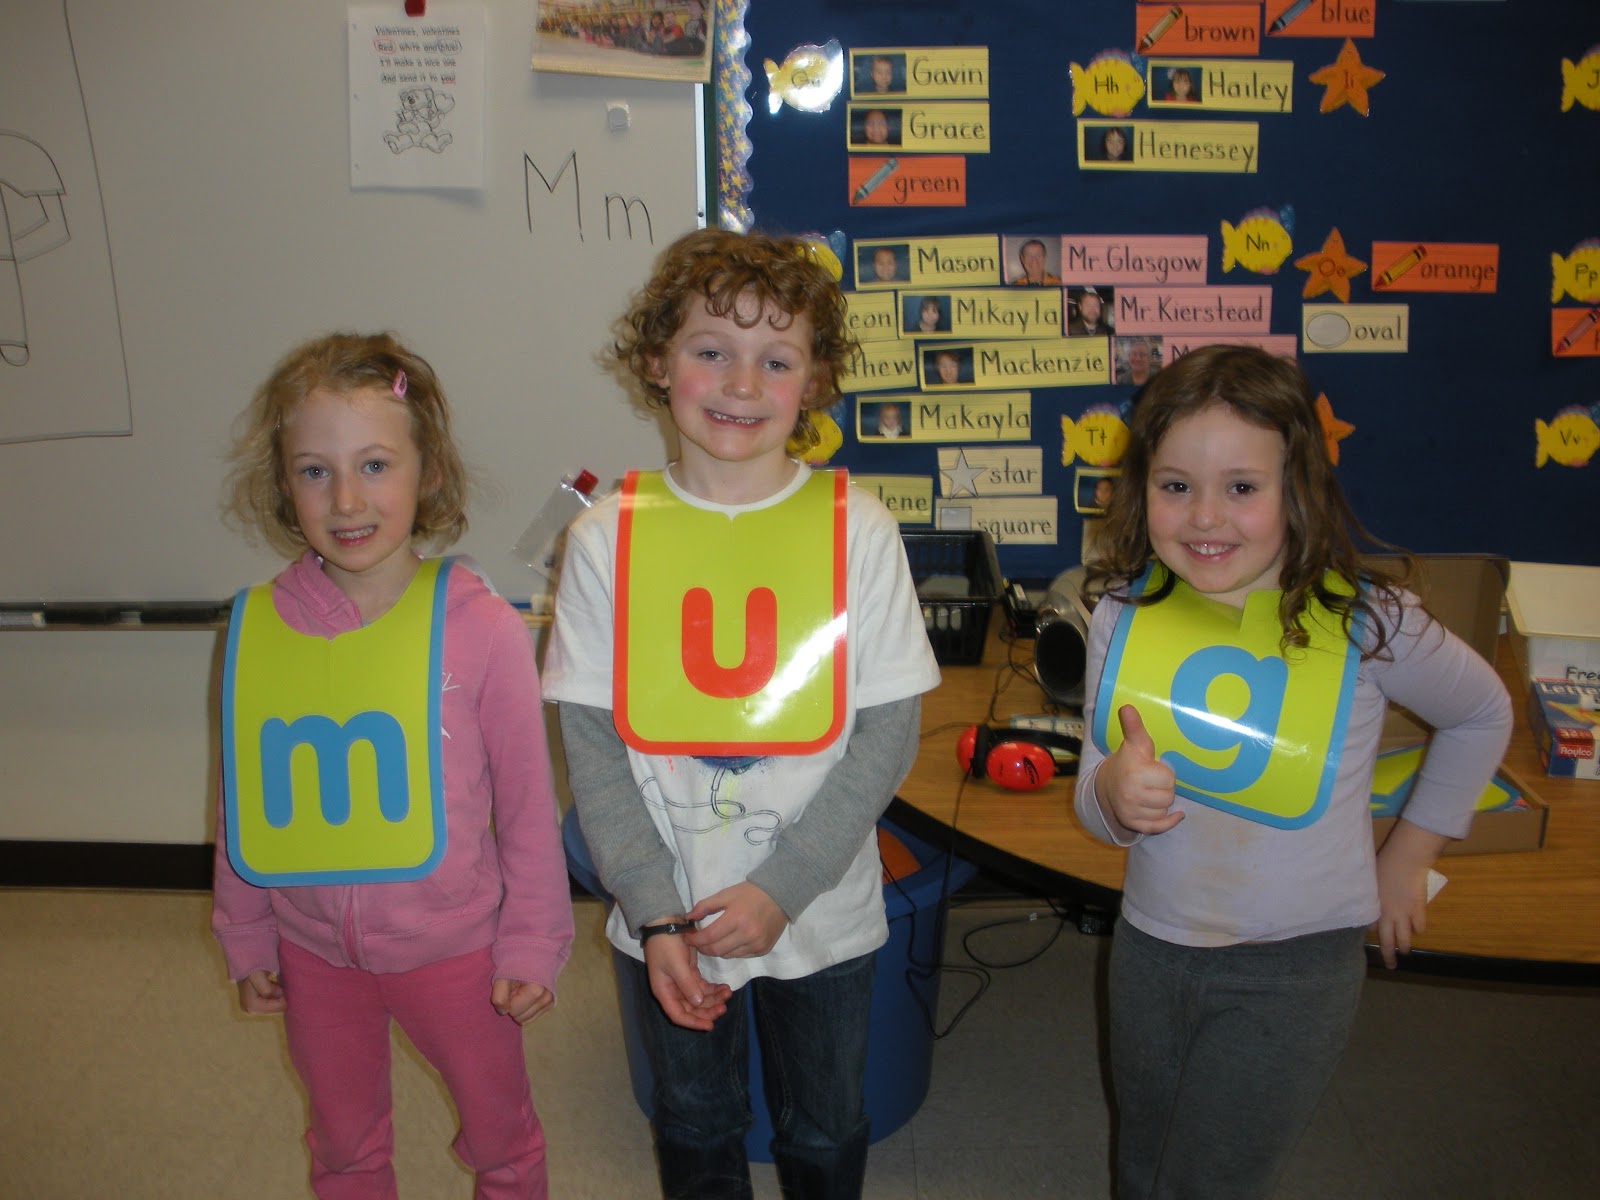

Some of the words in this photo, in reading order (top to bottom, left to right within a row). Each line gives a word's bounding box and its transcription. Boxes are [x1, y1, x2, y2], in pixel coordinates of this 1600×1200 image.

[1320, 0, 1371, 25] blue
[1185, 15, 1256, 43] brown
[399, 41, 420, 51] white
[424, 41, 437, 51] and
[394, 58, 414, 67] make
[425, 58, 440, 67] nice
[912, 55, 984, 87] Gavin
[382, 73, 396, 82] And
[400, 73, 417, 82] send
[1094, 72, 1119, 95] Hh
[1208, 68, 1288, 112] Hailey
[909, 110, 986, 140] Grace
[1139, 128, 1256, 173] Henessey
[893, 173, 960, 205] green
[1246, 234, 1270, 252] Nn
[917, 246, 995, 274] Mason
[1107, 244, 1202, 284] Glasgow
[1318, 257, 1346, 277] Oo
[1420, 262, 1496, 291] orange
[1575, 263, 1598, 289] Pp
[849, 312, 891, 329] eon
[957, 297, 1059, 335] Mikayla
[1158, 294, 1263, 323] Kierstead
[1355, 314, 1402, 341] oval
[850, 352, 913, 378] thew
[980, 347, 1105, 377] Mackenzie
[919, 403, 1030, 439] Makayla
[1085, 428, 1108, 447] Tt
[1559, 429, 1581, 446] Vv
[990, 457, 1037, 485] star
[879, 483, 929, 511] lene
[977, 517, 1052, 544] square
[681, 586, 778, 699] u
[1566, 666, 1600, 681] Fre
[1159, 644, 1289, 794] g
[1560, 746, 1593, 757] Roylco
[259, 710, 410, 828] m
